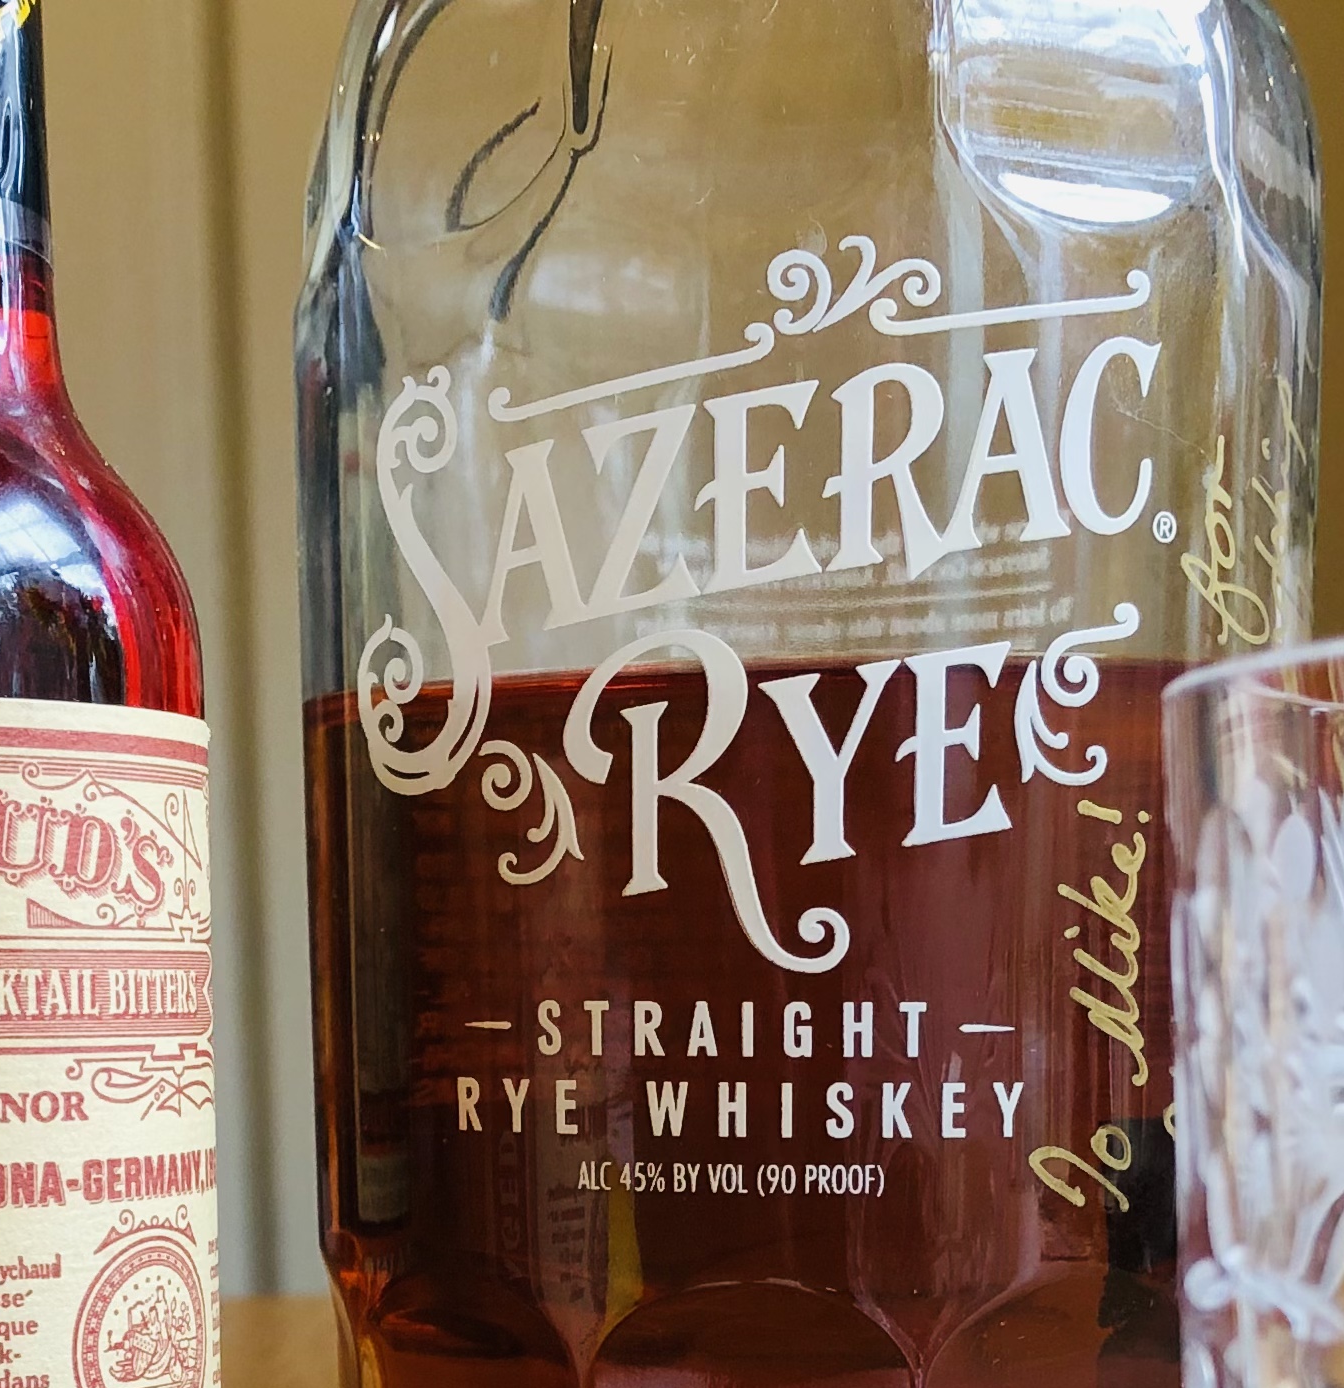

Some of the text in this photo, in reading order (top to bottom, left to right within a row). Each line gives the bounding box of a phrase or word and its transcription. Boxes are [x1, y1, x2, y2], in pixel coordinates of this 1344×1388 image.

[358, 337, 1159, 797] SAZERAC
[564, 628, 1011, 973] RYE
[109, 968, 199, 1014] BITTERS
[537, 1000, 928, 1058] STRAIGHT
[457, 1076, 1025, 1139] RYE WHISKEY
[577, 1160, 886, 1196] ALC 45% BY VOL (90 PROOF)
